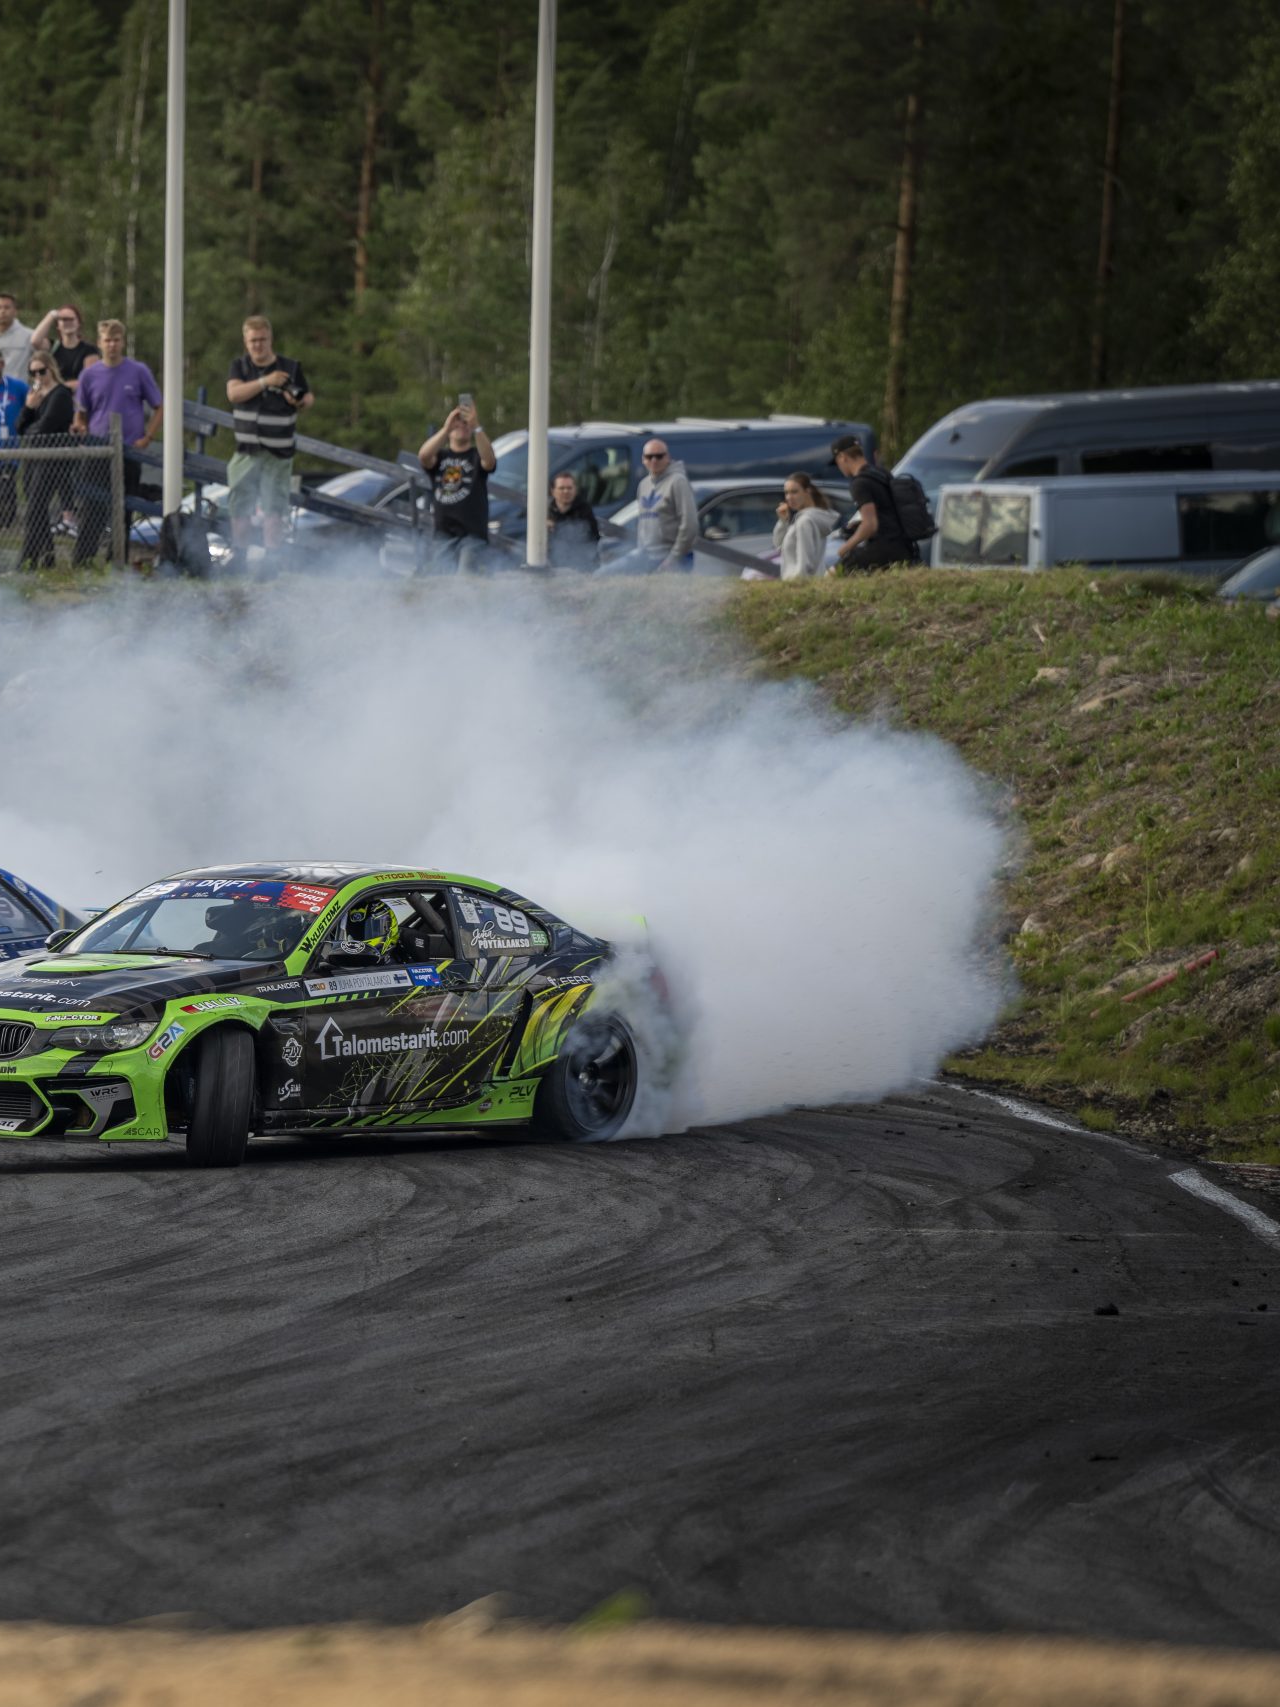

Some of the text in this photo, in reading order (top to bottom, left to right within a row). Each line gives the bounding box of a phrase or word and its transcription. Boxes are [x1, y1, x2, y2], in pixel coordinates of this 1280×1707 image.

[374, 872, 415, 882] TT-TOOLS
[195, 879, 255, 892] DRIFT
[294, 892, 325, 903] PRO
[494, 906, 530, 935] 89
[470, 920, 497, 946] Juha
[532, 932, 547, 944] E85
[478, 937, 530, 949] PÖYTÄLAAKSO
[328, 980, 338, 990] 89
[559, 975, 593, 985] FERR
[256, 981, 301, 993] TRAILANDER
[148, 1024, 185, 1059] G2A
[331, 1027, 470, 1057] Talomestarit.com
[90, 1086, 120, 1097] WRC
[508, 1084, 536, 1098] PLV
